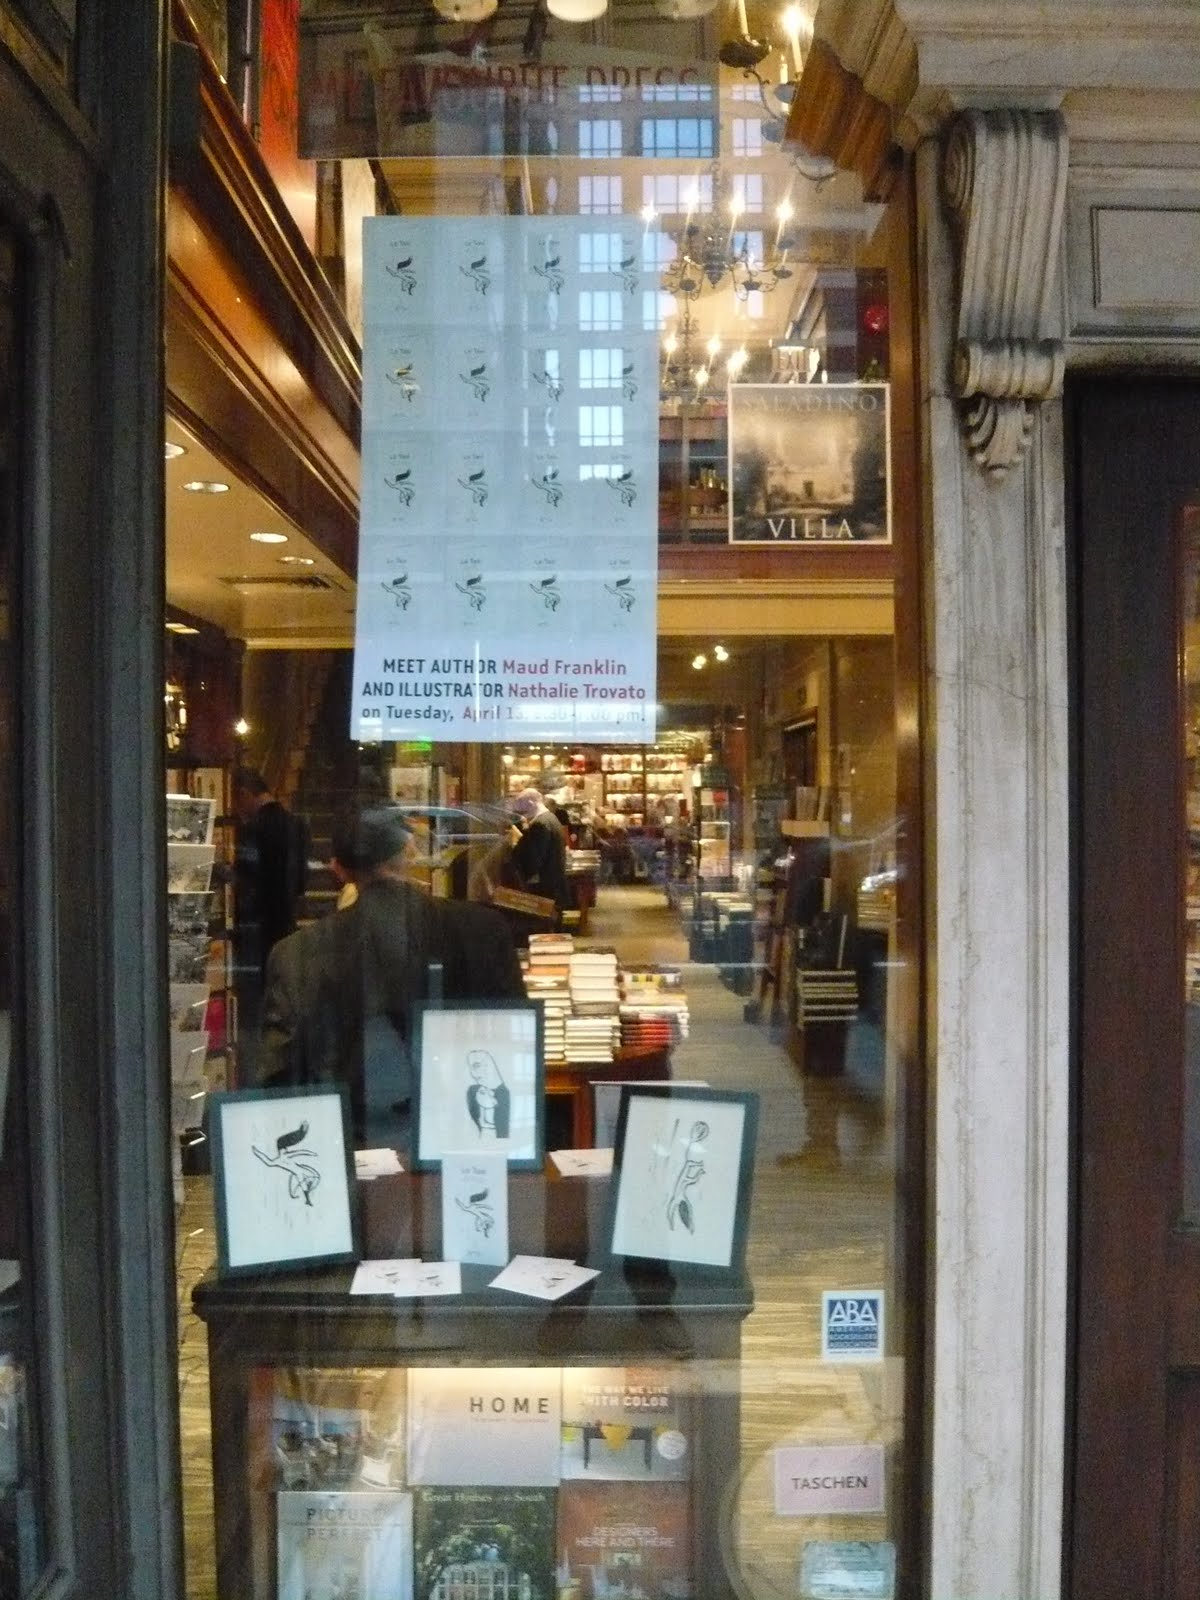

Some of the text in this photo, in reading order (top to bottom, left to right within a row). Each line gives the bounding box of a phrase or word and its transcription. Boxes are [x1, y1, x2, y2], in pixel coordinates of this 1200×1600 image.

[767, 518, 855, 539] VILLA
[383, 658, 627, 676] MEET AUTHOR Maud Franklin
[362, 681, 646, 700] AND ILLUSTRATOR Nathalie Trovato
[362, 707, 381, 719] on
[386, 705, 455, 723] Tuesday,
[462, 705, 500, 723] April
[829, 1300, 877, 1323] ABA
[469, 1396, 550, 1414] HOME
[624, 1396, 668, 1407] COLOR
[791, 1475, 868, 1490] TASCHEN
